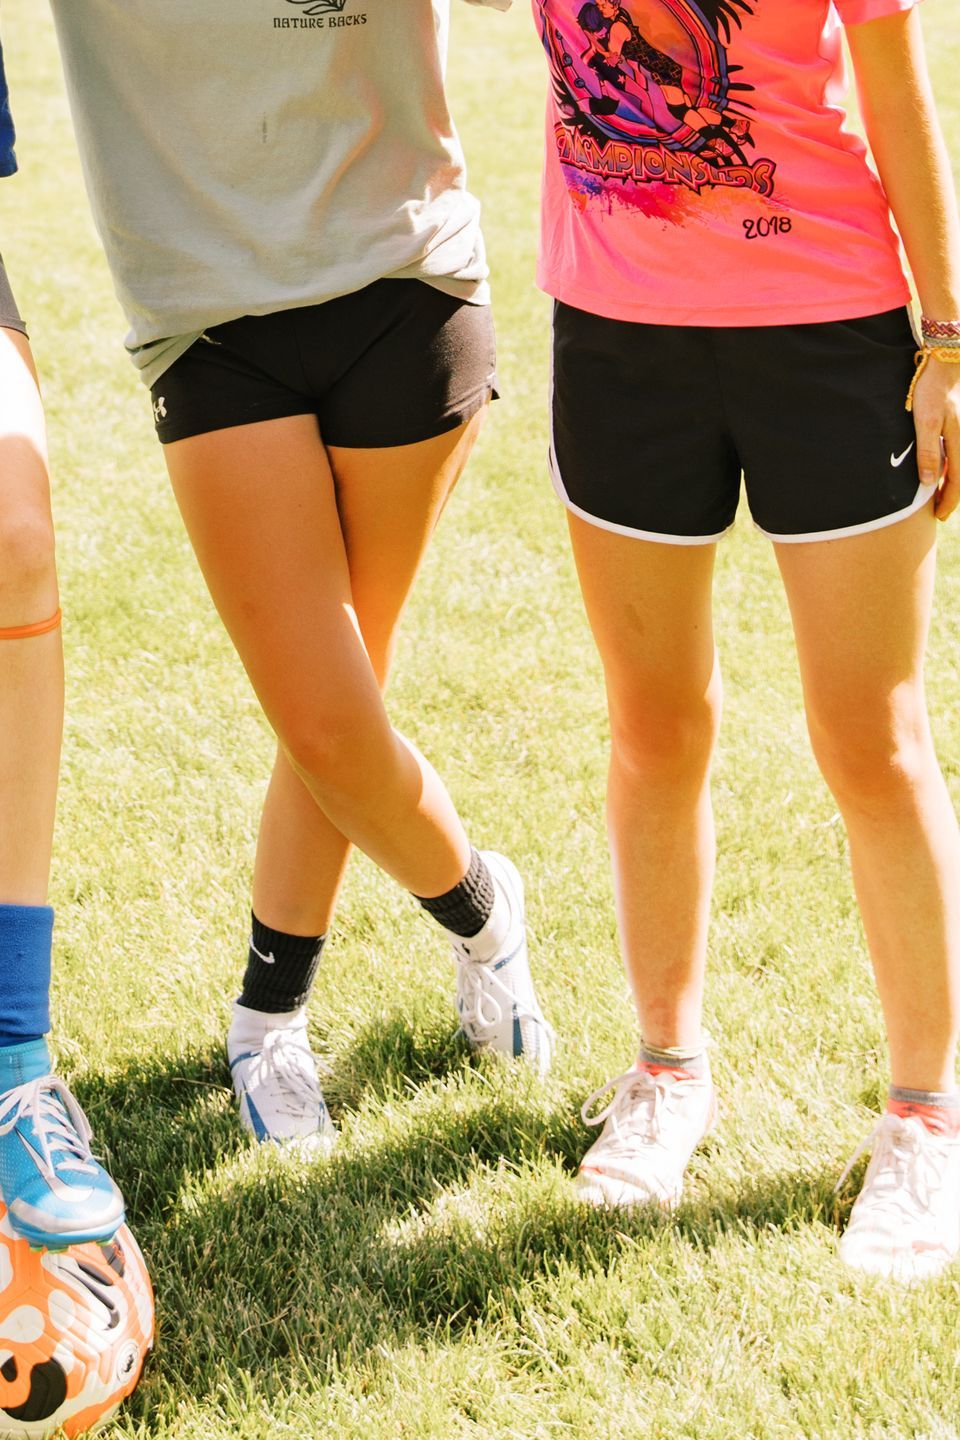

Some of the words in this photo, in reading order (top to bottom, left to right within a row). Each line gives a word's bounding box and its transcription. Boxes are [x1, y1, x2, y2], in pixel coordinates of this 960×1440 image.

[273, 17, 324, 29] NATURE
[328, 13, 367, 28] BACKS
[742, 215, 793, 240] 2018
